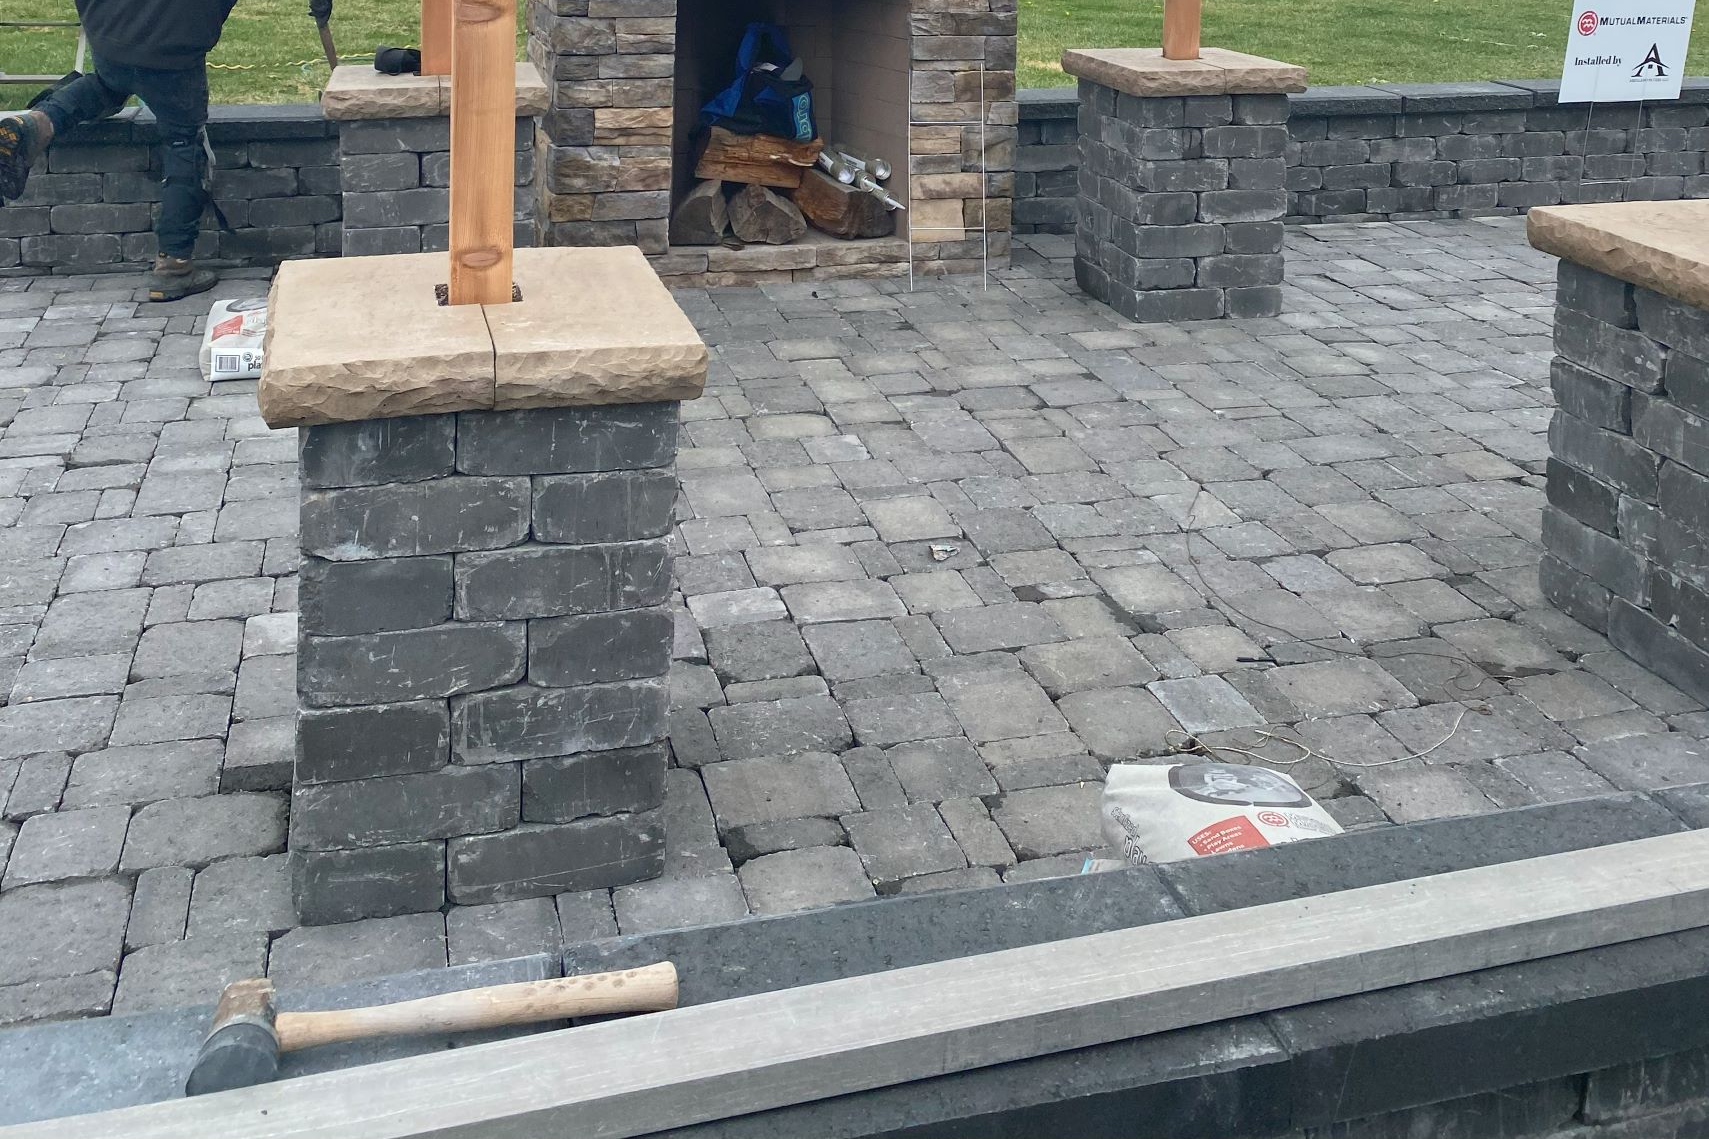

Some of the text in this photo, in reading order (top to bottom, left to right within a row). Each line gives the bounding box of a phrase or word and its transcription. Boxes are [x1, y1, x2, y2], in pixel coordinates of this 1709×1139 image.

[1574, 55, 1622, 67] Installed by
[1202, 832, 1220, 844] Sand
[1206, 839, 1222, 850] Play
